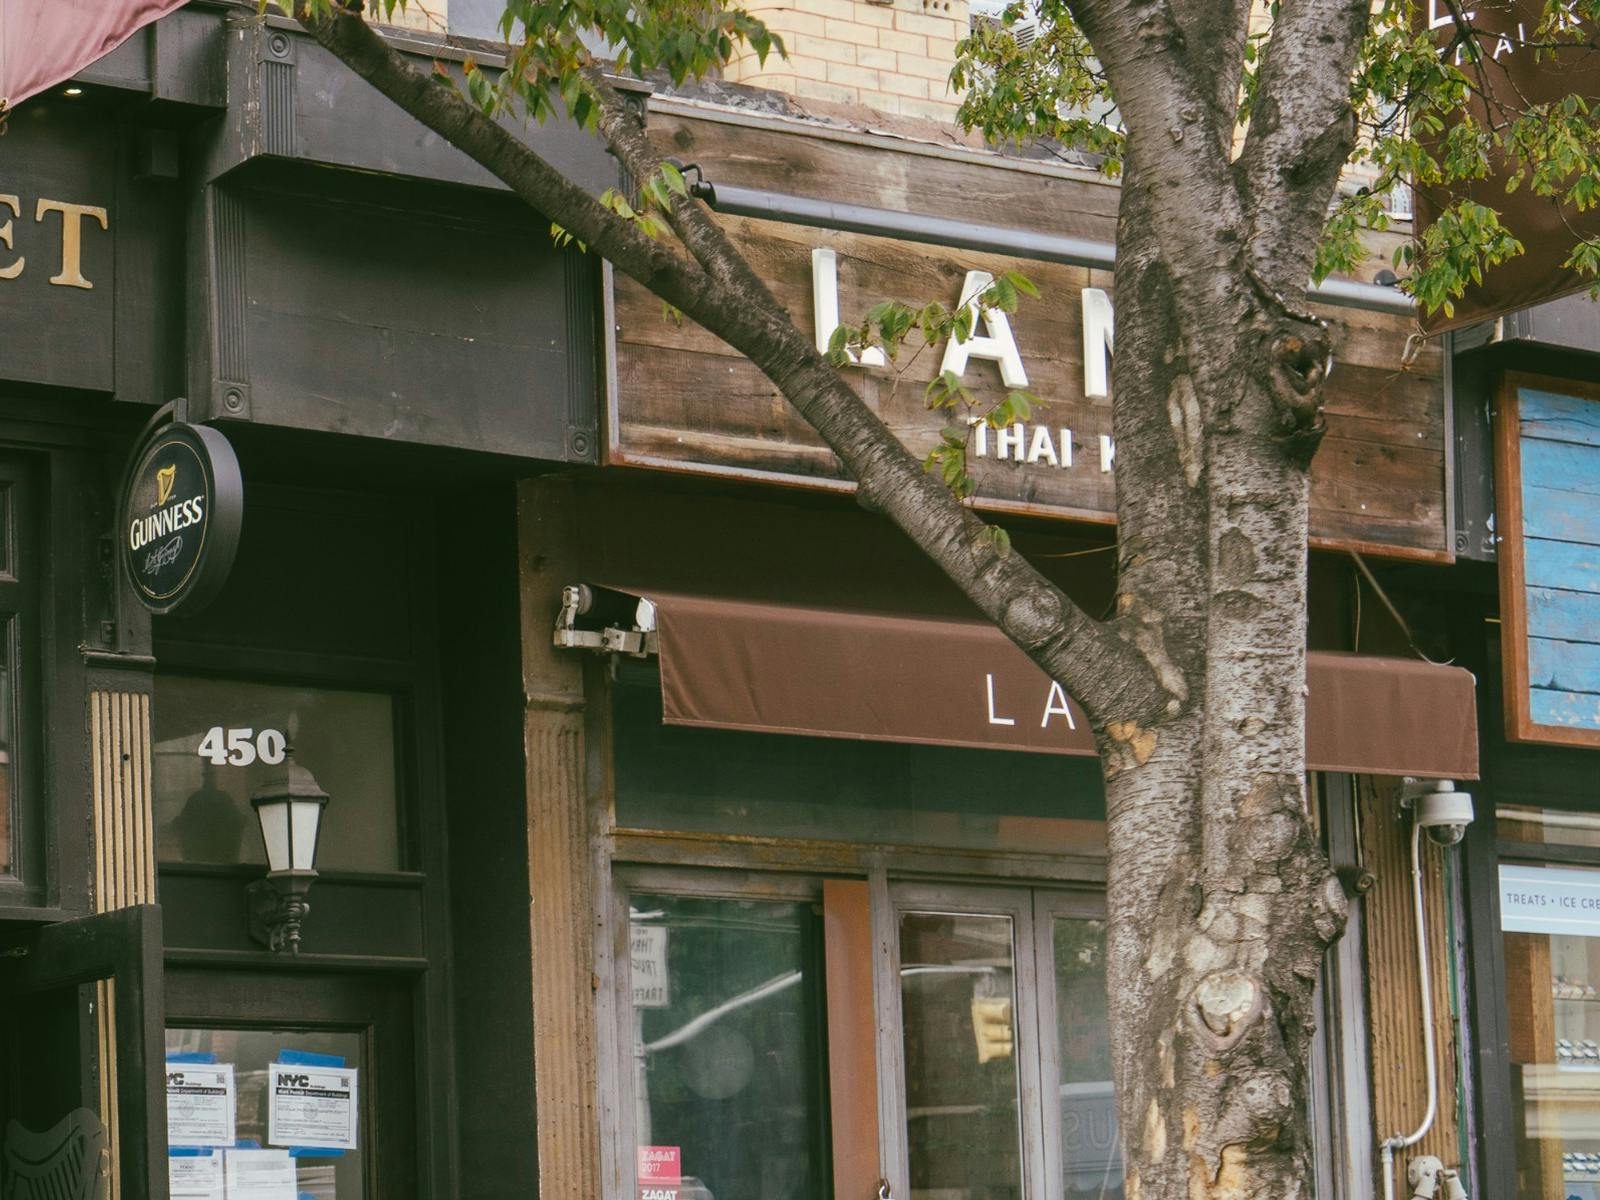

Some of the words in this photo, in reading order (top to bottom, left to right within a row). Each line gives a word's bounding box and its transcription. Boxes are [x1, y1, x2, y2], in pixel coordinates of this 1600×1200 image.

[966, 416, 1073, 468] THAI
[130, 496, 203, 551] GUINNESS
[198, 726, 287, 767] 450
[1506, 893, 1546, 906] TREATS
[1559, 897, 1577, 909] ICE
[277, 1073, 310, 1088] NYC
[642, 1189, 678, 1200] ZAGAT
